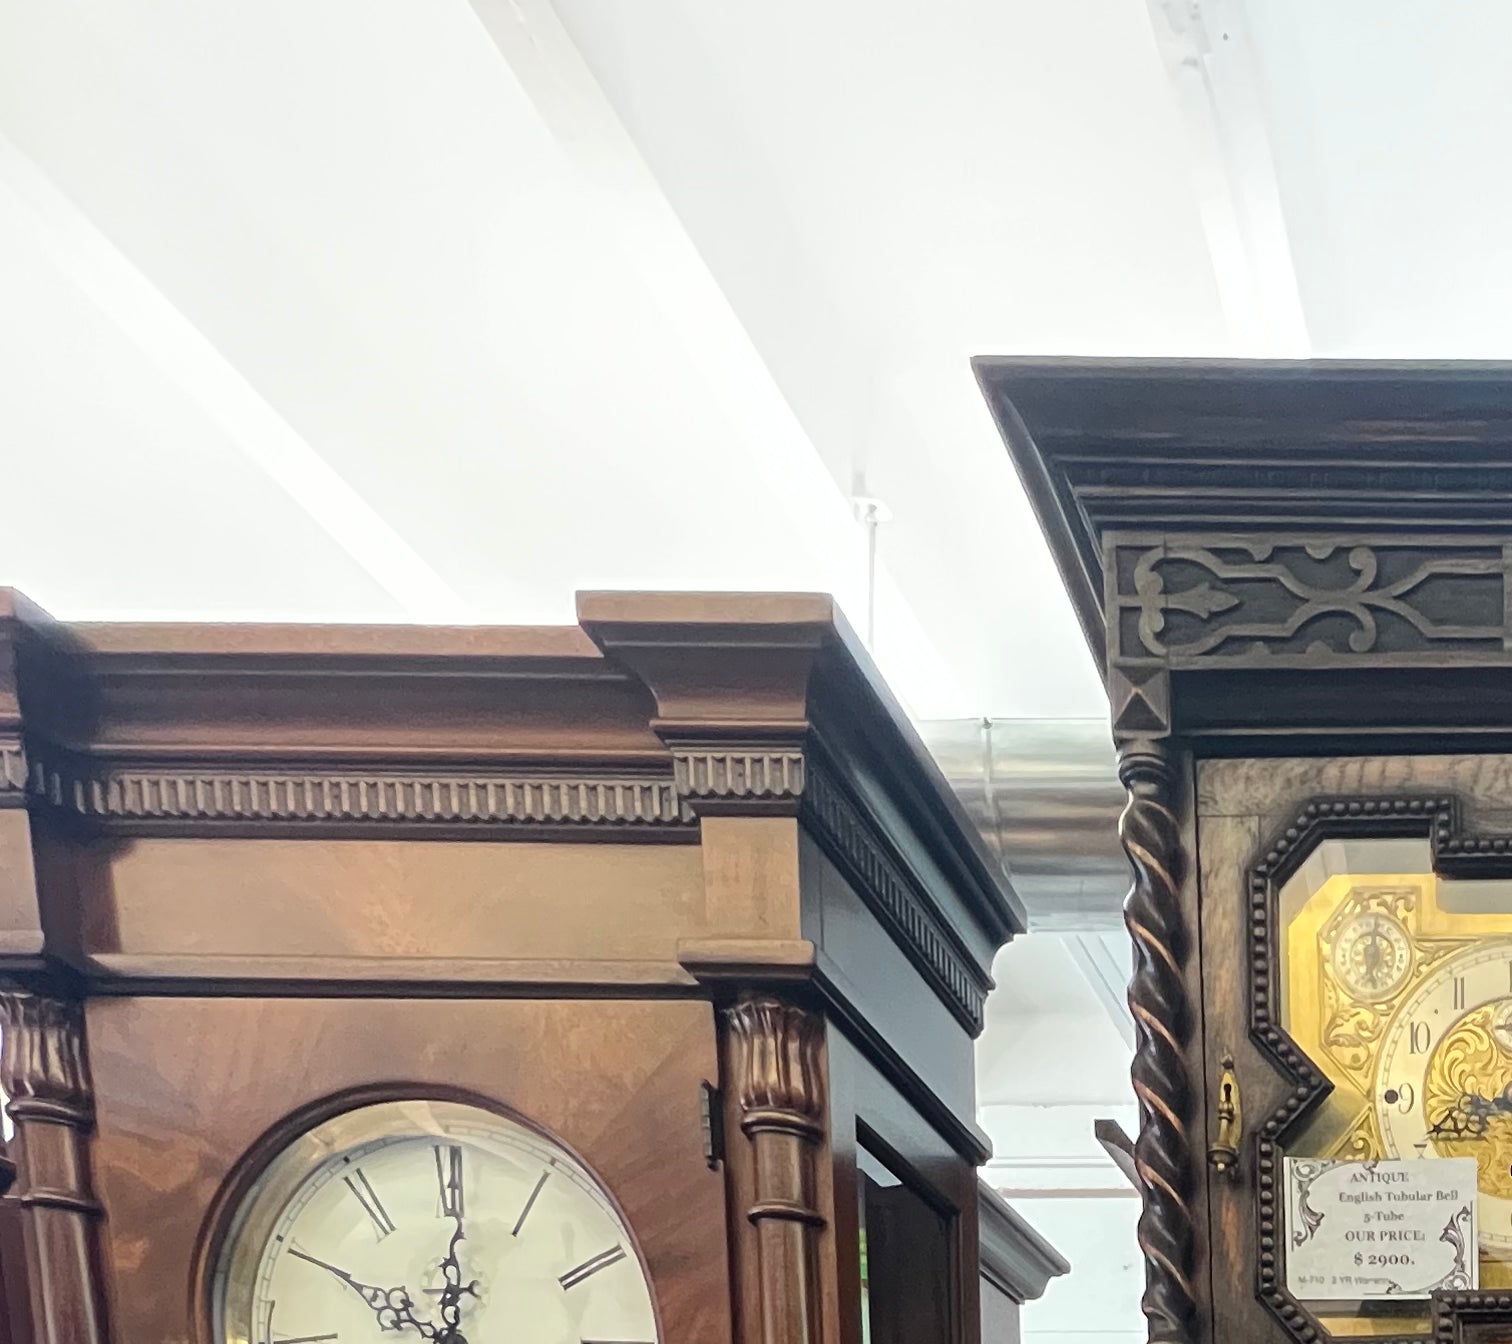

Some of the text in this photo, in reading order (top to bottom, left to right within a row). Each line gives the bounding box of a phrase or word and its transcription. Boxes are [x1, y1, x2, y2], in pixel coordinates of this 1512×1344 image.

[1453, 977, 1465, 1011] 11
[1410, 1021, 1431, 1055] 10
[1398, 1082, 1414, 1115] 9
[1350, 1171, 1409, 1184] ANTIQUE
[1338, 1189, 1458, 1204] English Tubular Bell
[1363, 1210, 1405, 1223] 5-Tube
[1345, 1230, 1376, 1242] OUR
